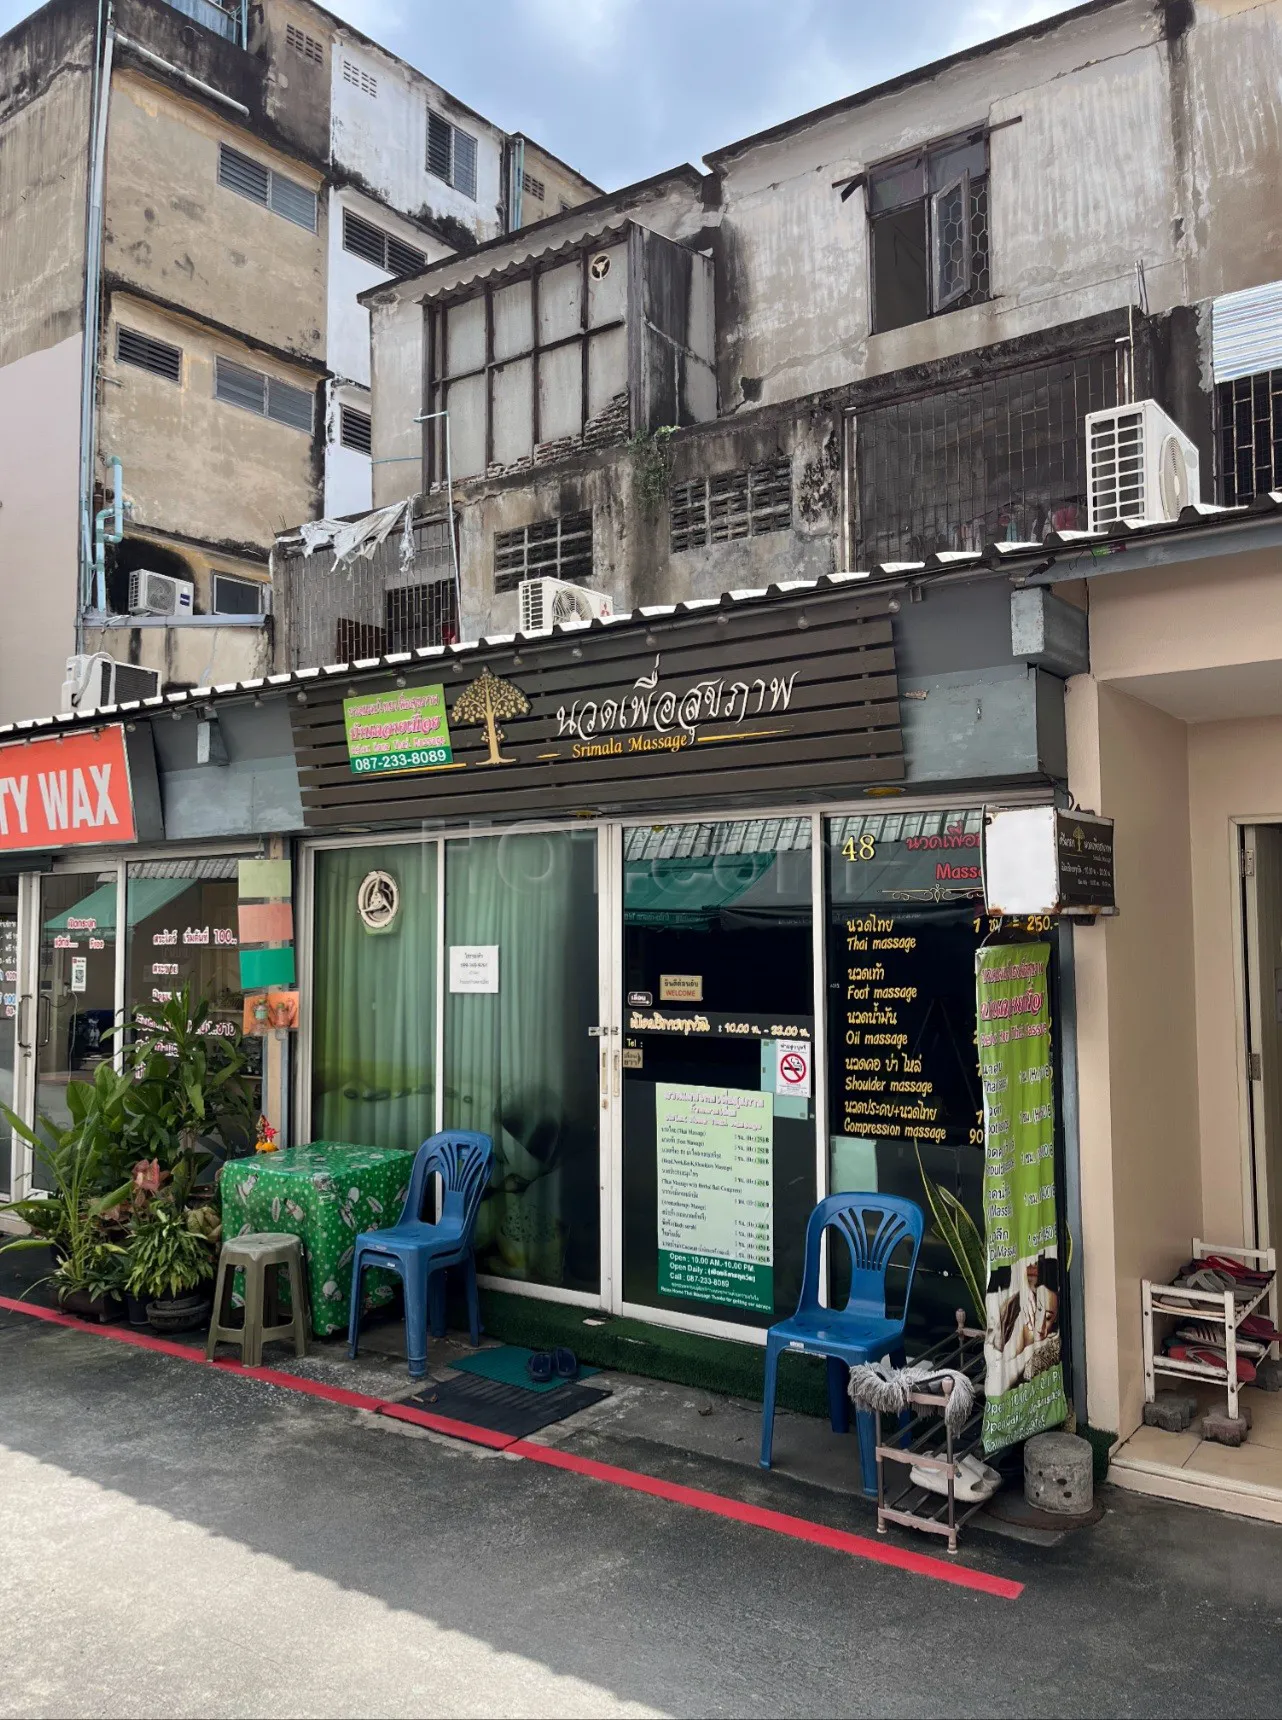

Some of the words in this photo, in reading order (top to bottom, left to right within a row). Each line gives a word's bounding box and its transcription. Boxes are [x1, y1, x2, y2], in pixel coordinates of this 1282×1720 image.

[556, 653, 800, 745] นวดเพื่อสุขภาพ
[572, 742, 622, 758] Srimala
[628, 733, 687, 753] Massage
[355, 749, 447, 771] 087-233-8089
[37, 763, 119, 831] WAX
[841, 834, 875, 862] 48
[847, 914, 894, 932] นวดไทย
[973, 918, 981, 934] 1
[847, 936, 868, 951] Thai
[872, 936, 917, 953] massage
[847, 963, 885, 981] นวดเท้า
[665, 989, 696, 997] WELCOME
[847, 984, 870, 999] Foot
[873, 985, 918, 1003] massage
[847, 1002, 898, 1026] นวดน้ำมัน
[724, 1022, 750, 1034] 10.00
[626, 1038, 637, 1047] Tel
[845, 1030, 860, 1045] Oil
[864, 1033, 908, 1049] massage
[845, 1057, 881, 1072] นวดคอ
[886, 1053, 899, 1072] บ่า
[901, 1052, 922, 1074] ไหล่
[845, 1074, 886, 1091] Shoulder
[890, 1080, 933, 1098] massage
[844, 1099, 938, 1121] นวดประคบ+นวดไทย
[844, 1117, 901, 1138] Compression
[904, 1125, 947, 1144] massage
[669, 1252, 687, 1263] Open
[669, 1262, 687, 1271] Open
[687, 1263, 703, 1275] Daily
[669, 1272, 682, 1281] Call
